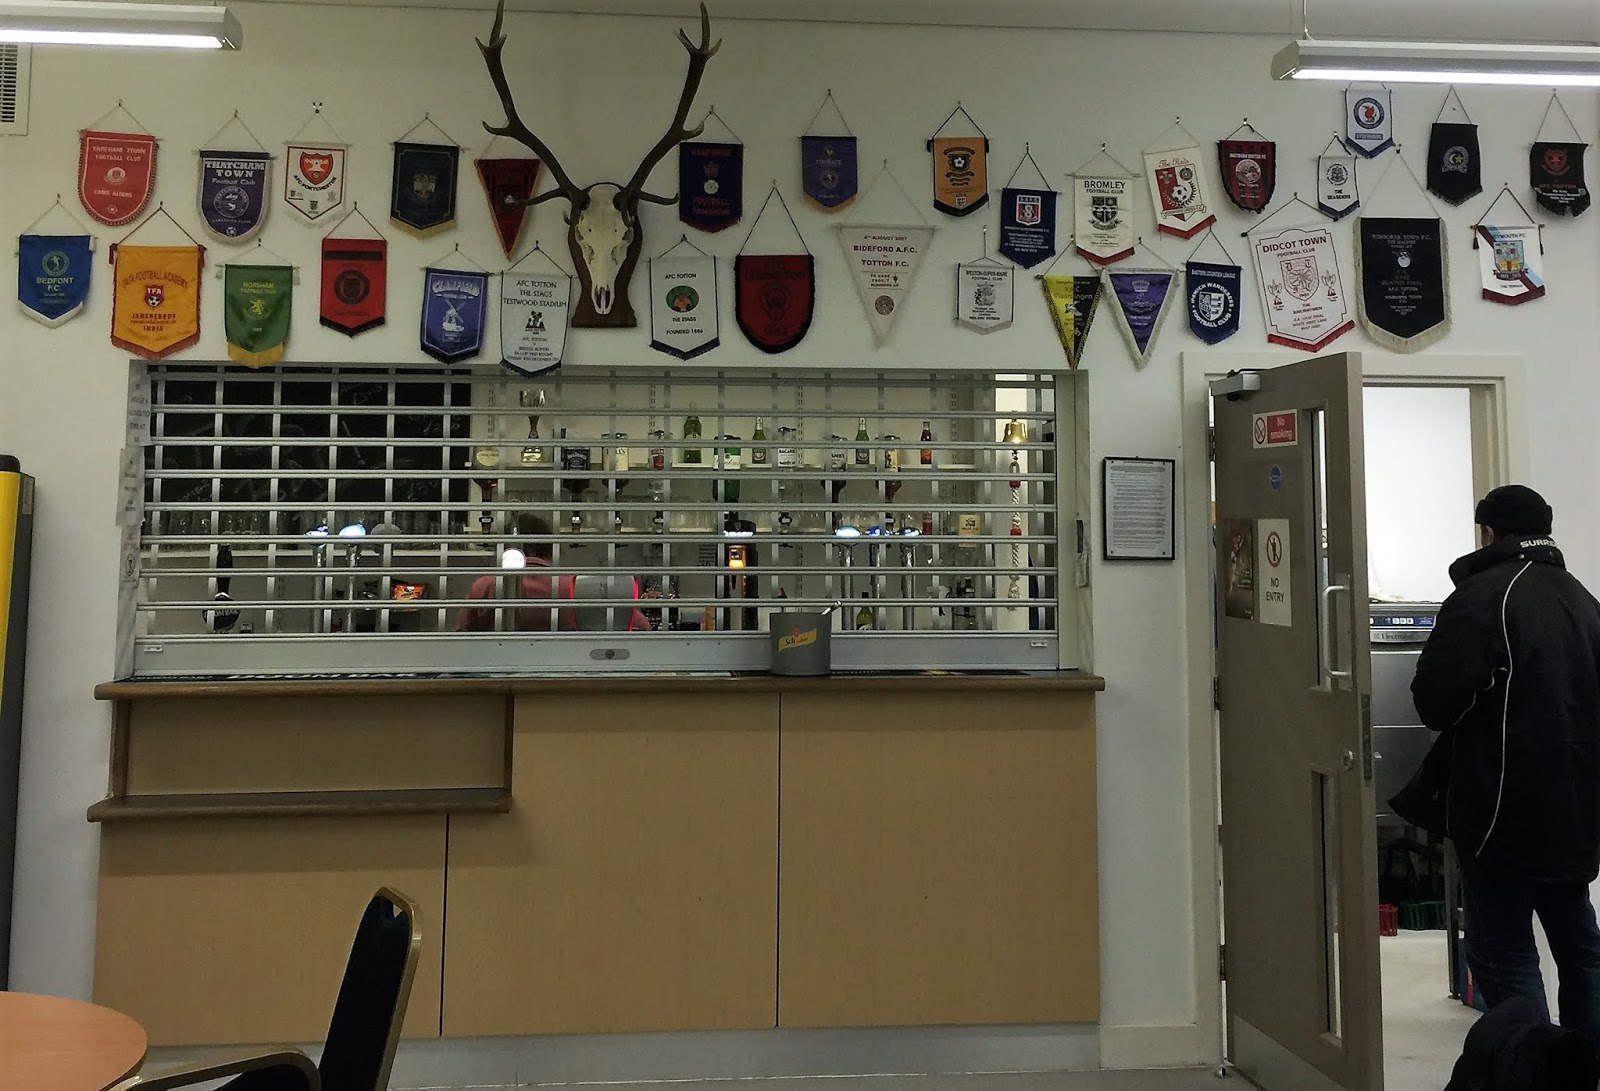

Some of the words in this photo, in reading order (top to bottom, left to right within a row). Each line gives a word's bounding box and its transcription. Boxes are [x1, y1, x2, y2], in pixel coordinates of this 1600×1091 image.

[205, 161, 265, 170] THATCHAM
[216, 169, 254, 178] TOWN
[293, 175, 303, 185] AFC
[1084, 180, 1126, 189] BROMLEY
[1262, 240, 1296, 253] DIDCOT
[1298, 235, 1327, 247] TOWN
[853, 245, 894, 253] BIDEFORD
[895, 246, 918, 254] A.F.C.
[1276, 250, 1302, 258] FOOTBALL
[861, 259, 893, 267] TOTTON
[36, 276, 74, 285] BEDFONT
[147, 287, 162, 295] TFA
[533, 290, 552, 298] STAGS
[1190, 283, 1207, 304] IPSWICH
[1206, 282, 1235, 307] WANDERERS
[503, 297, 538, 306] TESTWOOD
[539, 300, 567, 308] STADIUM
[1192, 309, 1218, 328] FOOTBALL
[1217, 312, 1232, 326] CLUB
[1276, 416, 1286, 426] No
[1270, 428, 1293, 440] smoking
[1270, 577, 1280, 588] NO
[1265, 591, 1285, 602] ENTRY
